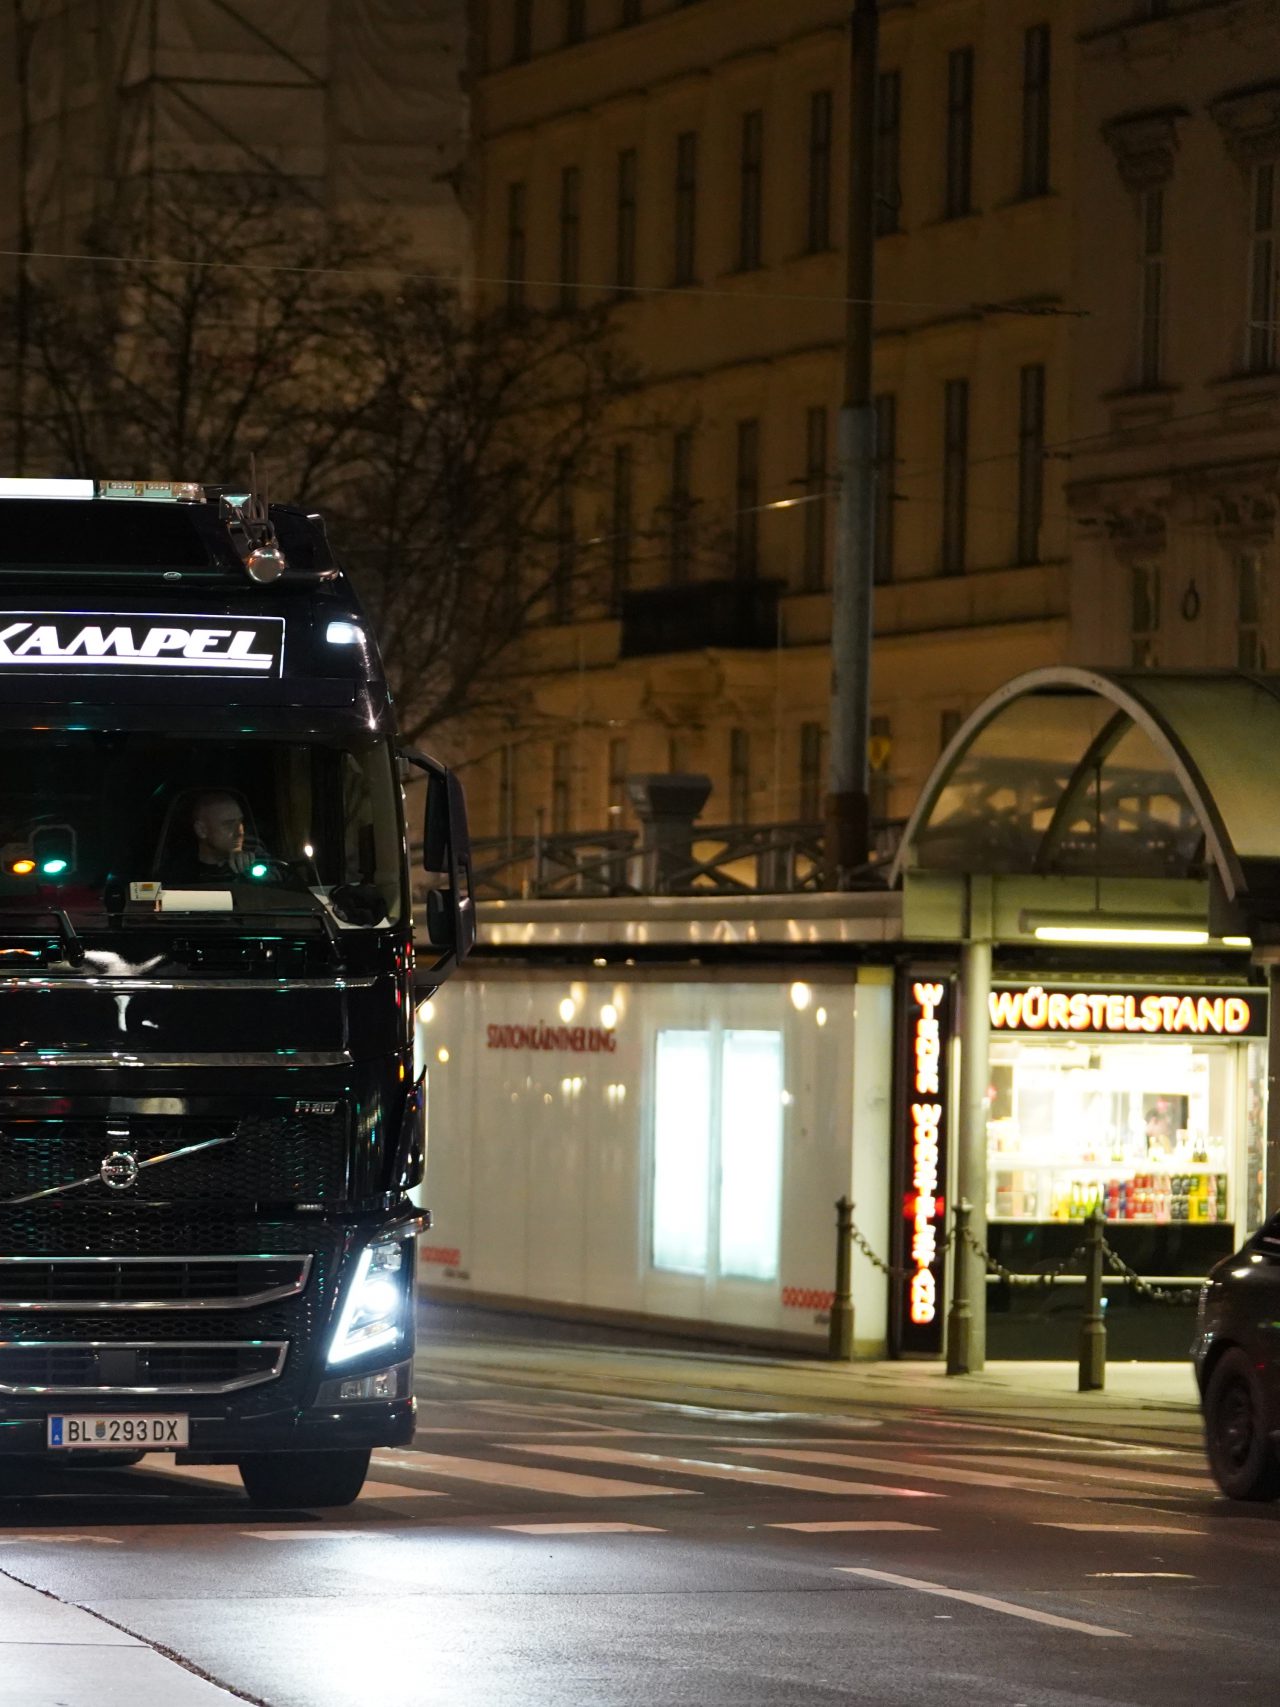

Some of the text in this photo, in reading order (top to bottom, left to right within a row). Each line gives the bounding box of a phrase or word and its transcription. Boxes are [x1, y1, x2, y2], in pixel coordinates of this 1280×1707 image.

[988, 986, 1251, 1033] WÜRSTELSTAND
[68, 1420, 92, 1442] BL
[109, 1420, 148, 1442] 293
[153, 1420, 179, 1442] DX
